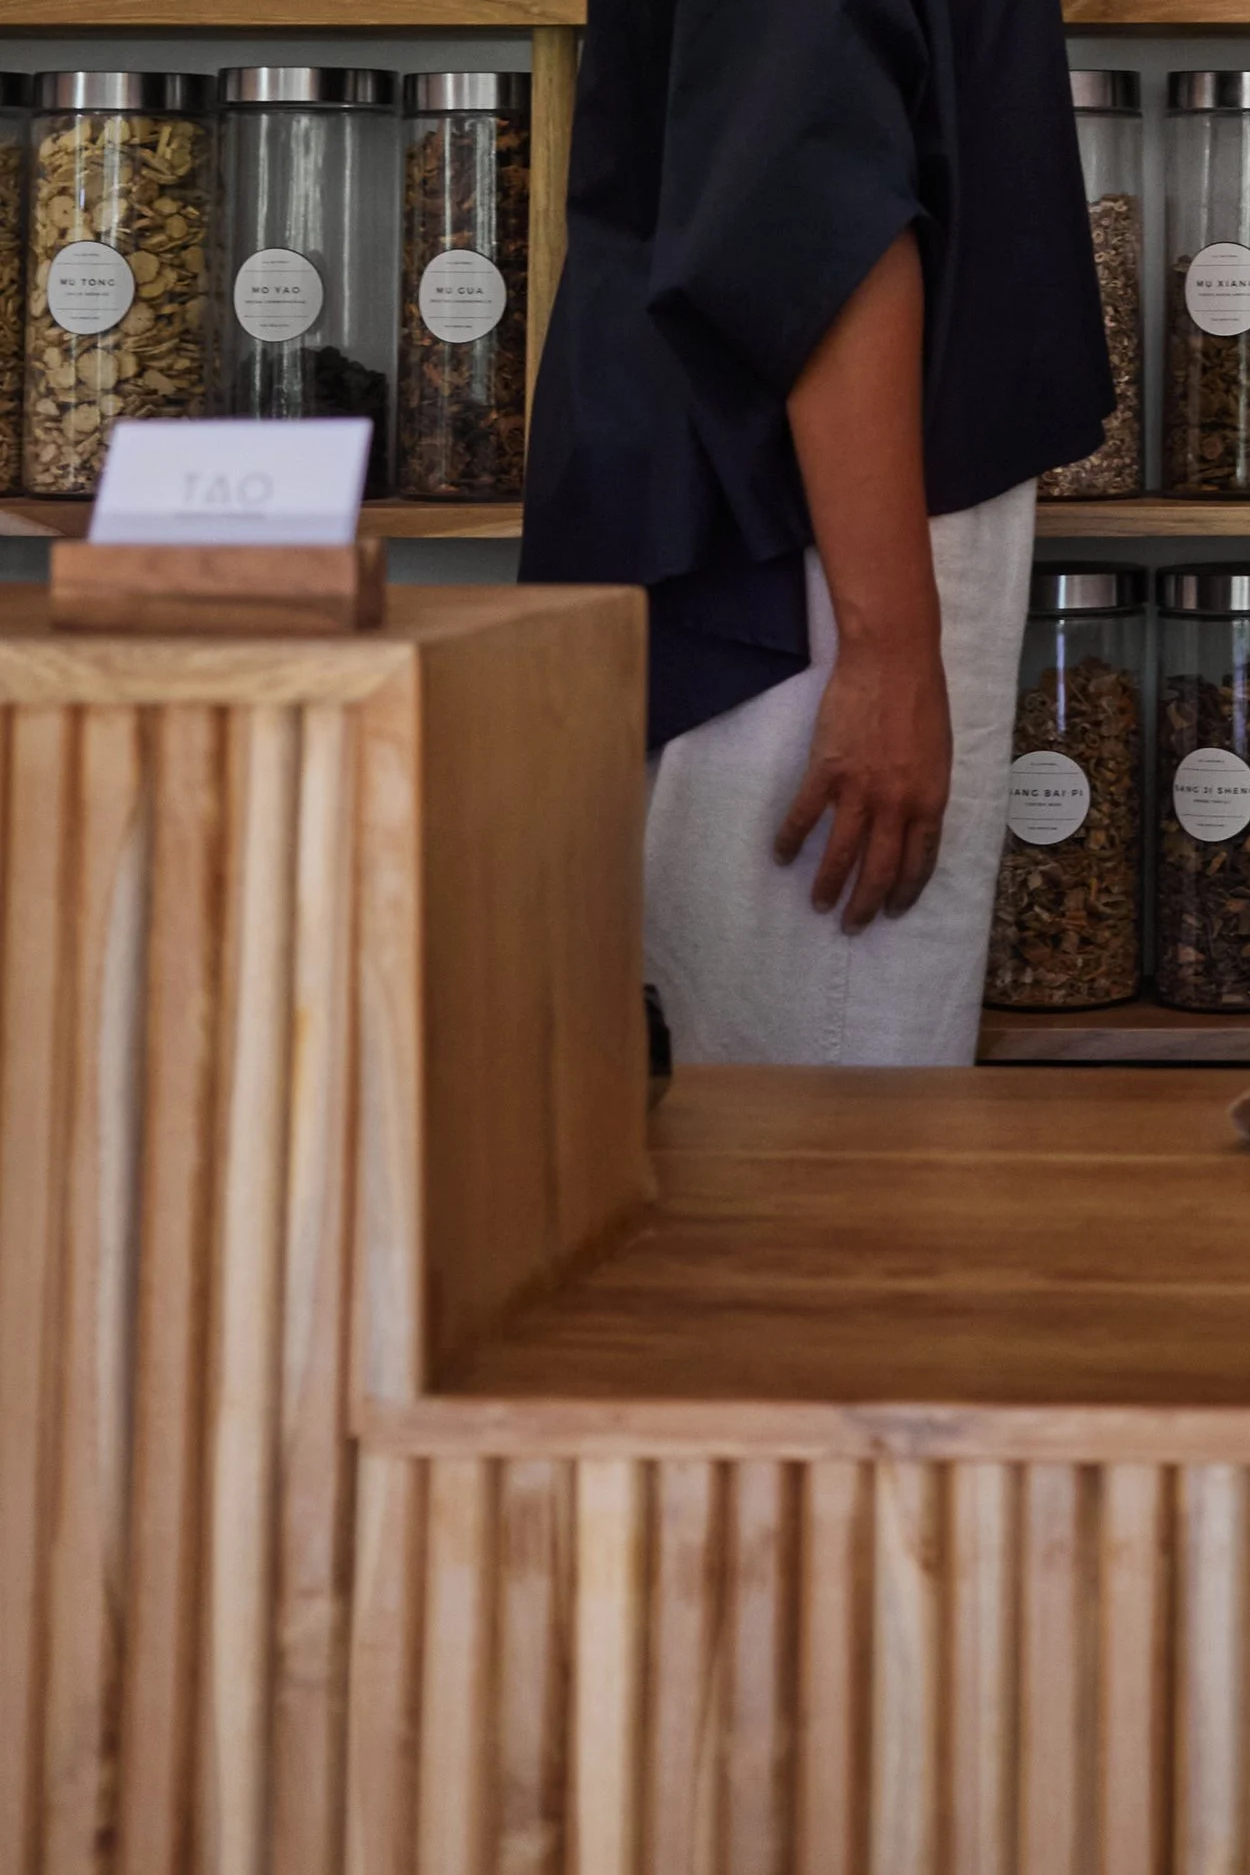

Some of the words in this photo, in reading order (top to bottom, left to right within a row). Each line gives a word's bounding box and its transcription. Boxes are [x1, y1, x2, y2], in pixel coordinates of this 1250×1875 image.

[60, 278, 76, 286] MU
[81, 278, 115, 286] TONG
[252, 286, 269, 294] MO
[275, 286, 301, 294] YAO
[457, 287, 484, 295] GUA
[182, 470, 275, 506] TAO
[1044, 789, 1066, 797] BAI
[1071, 789, 1083, 797] PI
[1202, 786, 1213, 794] JI
